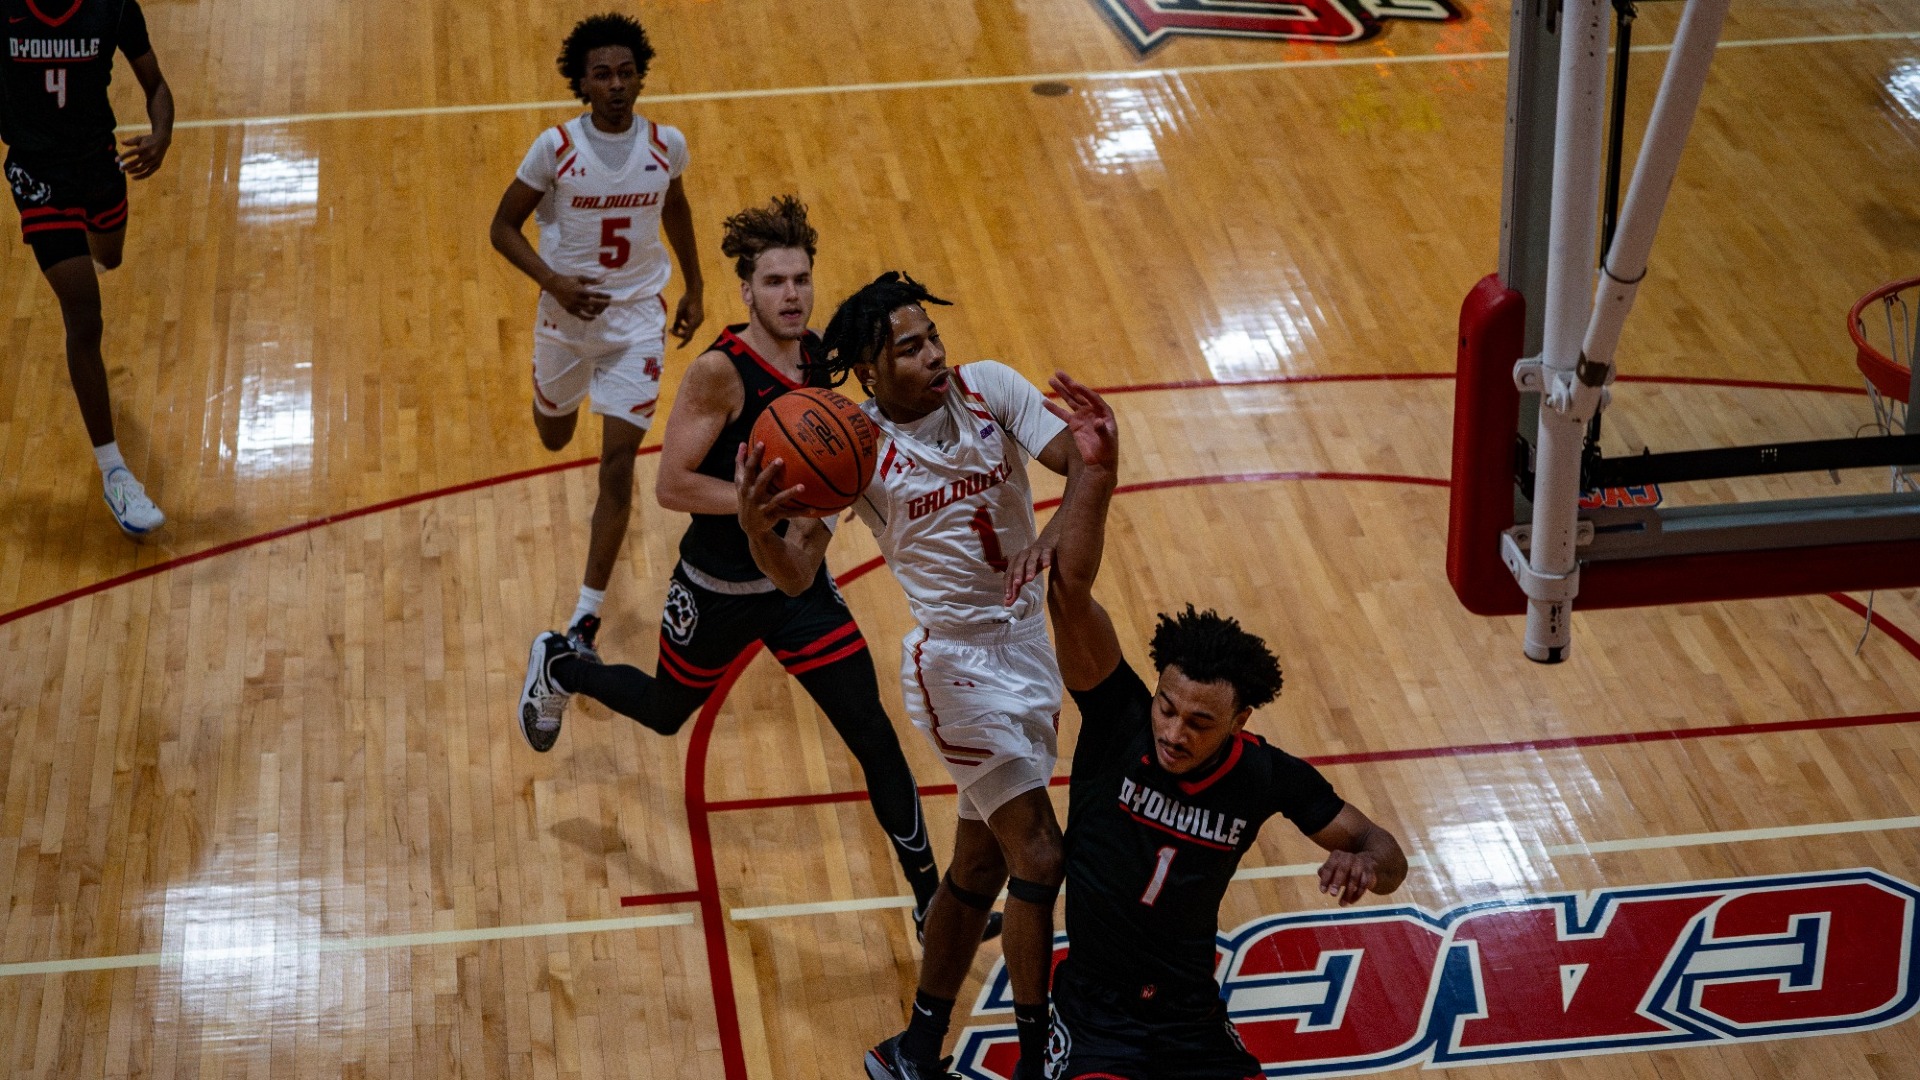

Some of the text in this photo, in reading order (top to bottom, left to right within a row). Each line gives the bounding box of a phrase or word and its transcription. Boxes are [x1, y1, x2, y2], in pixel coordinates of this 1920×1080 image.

[45, 68, 66, 109] 4
[571, 192, 659, 210] CALDWELL
[599, 217, 632, 270] 5
[968, 505, 1009, 573] 1
[1140, 846, 1178, 907] 1
